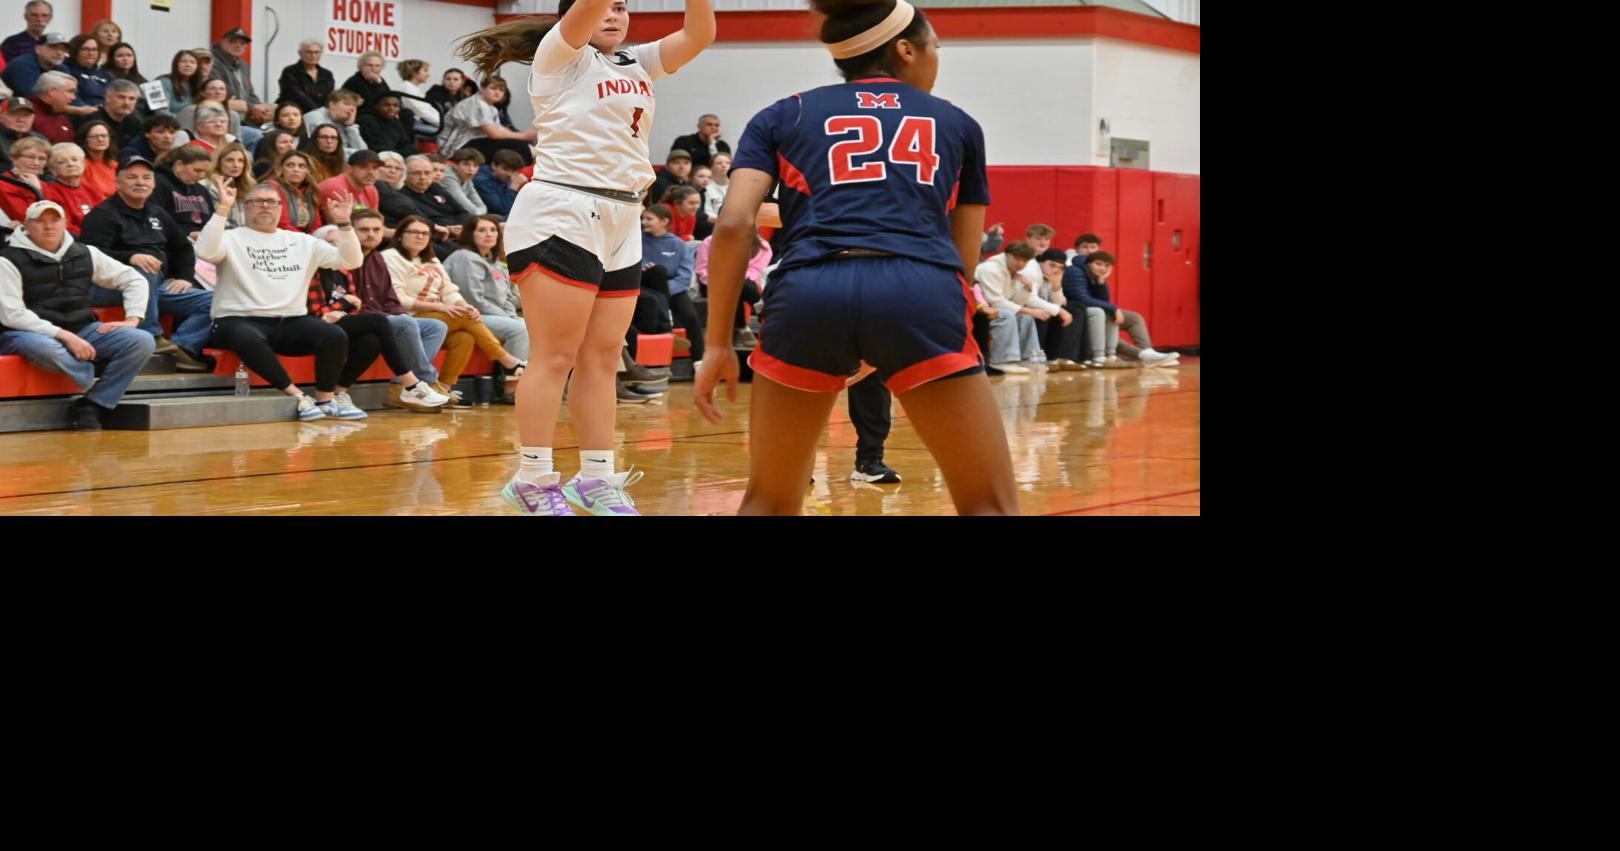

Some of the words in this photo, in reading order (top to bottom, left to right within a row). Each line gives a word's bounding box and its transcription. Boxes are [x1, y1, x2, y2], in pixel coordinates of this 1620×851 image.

[333, 0, 394, 27] HOME
[328, 27, 399, 58] STUDENTS
[597, 79, 655, 99] INDIA
[855, 92, 901, 109] M
[630, 106, 644, 138] 1
[824, 115, 939, 186] 24
